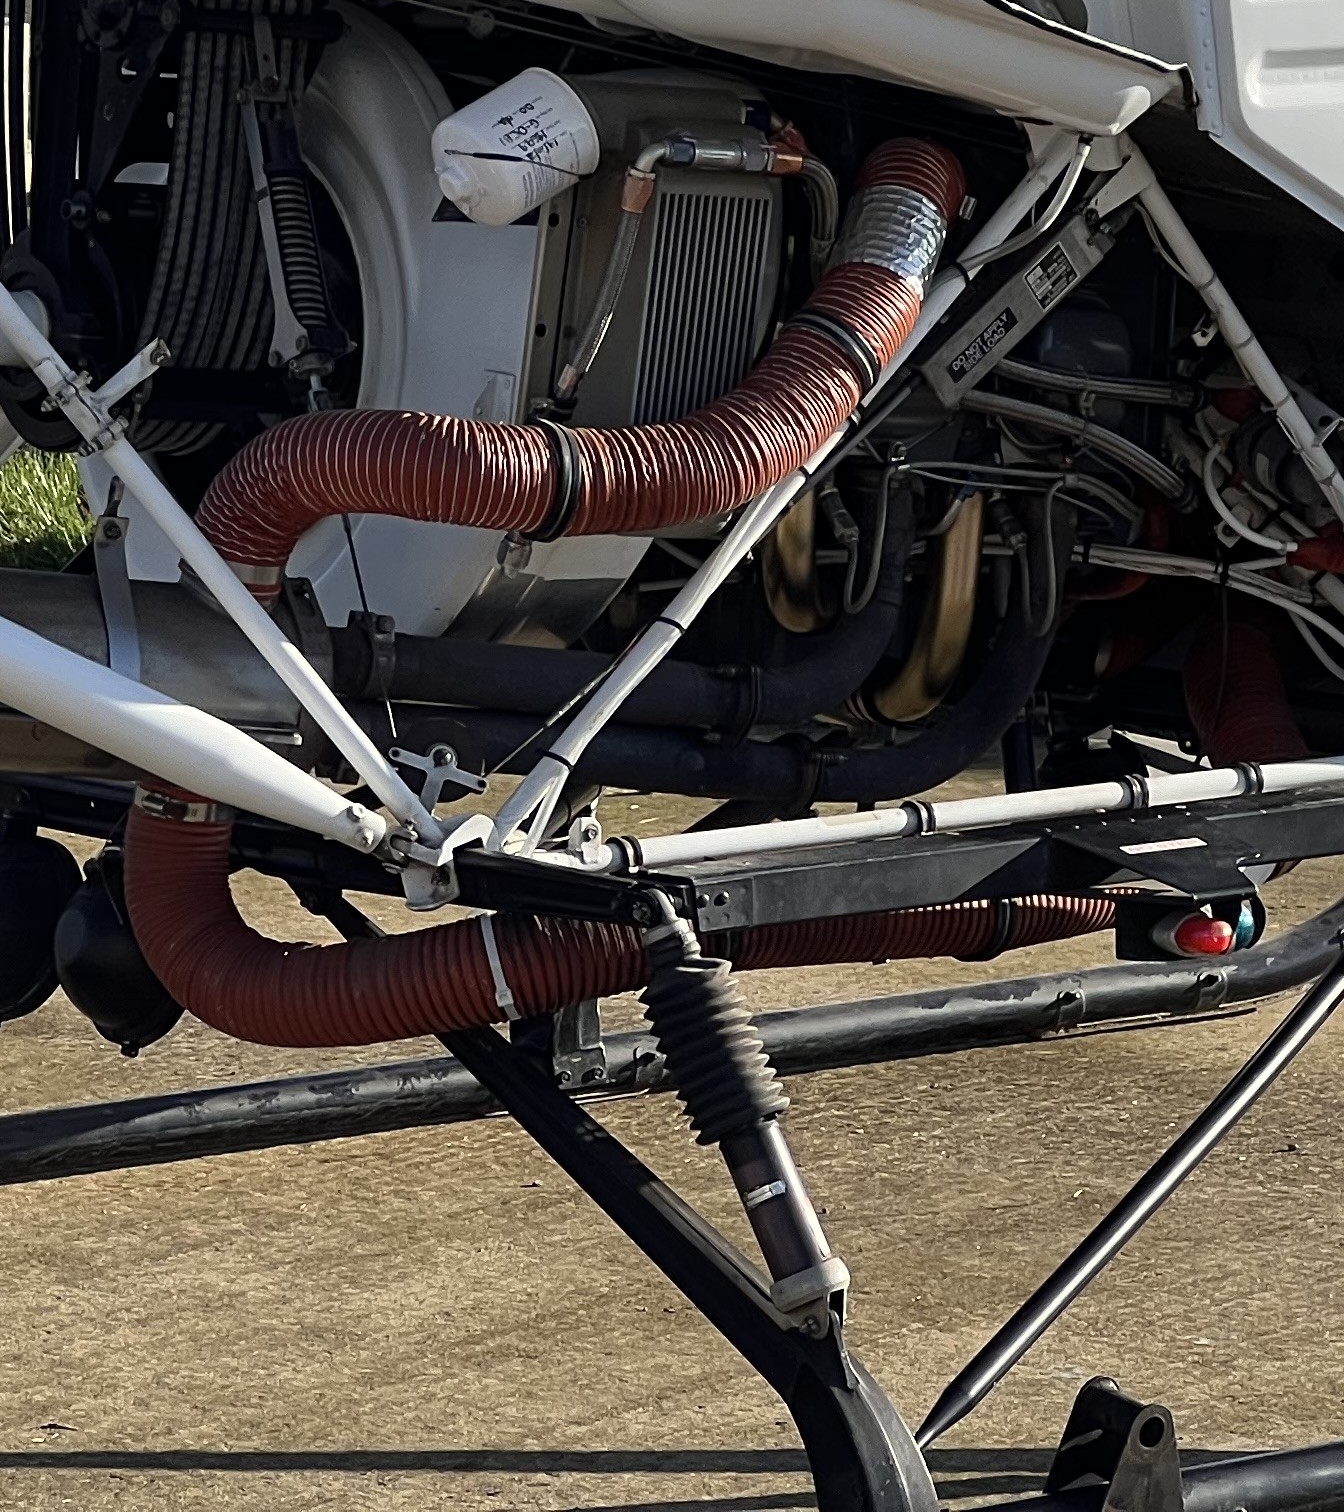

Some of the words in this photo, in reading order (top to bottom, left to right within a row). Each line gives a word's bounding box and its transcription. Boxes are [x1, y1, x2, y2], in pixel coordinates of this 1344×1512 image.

[952, 355, 966, 371] DO
[965, 337, 983, 357] NOT
[983, 312, 1008, 338] APPLY
[963, 350, 984, 371] SIDE
[983, 327, 1006, 353] LOAD
